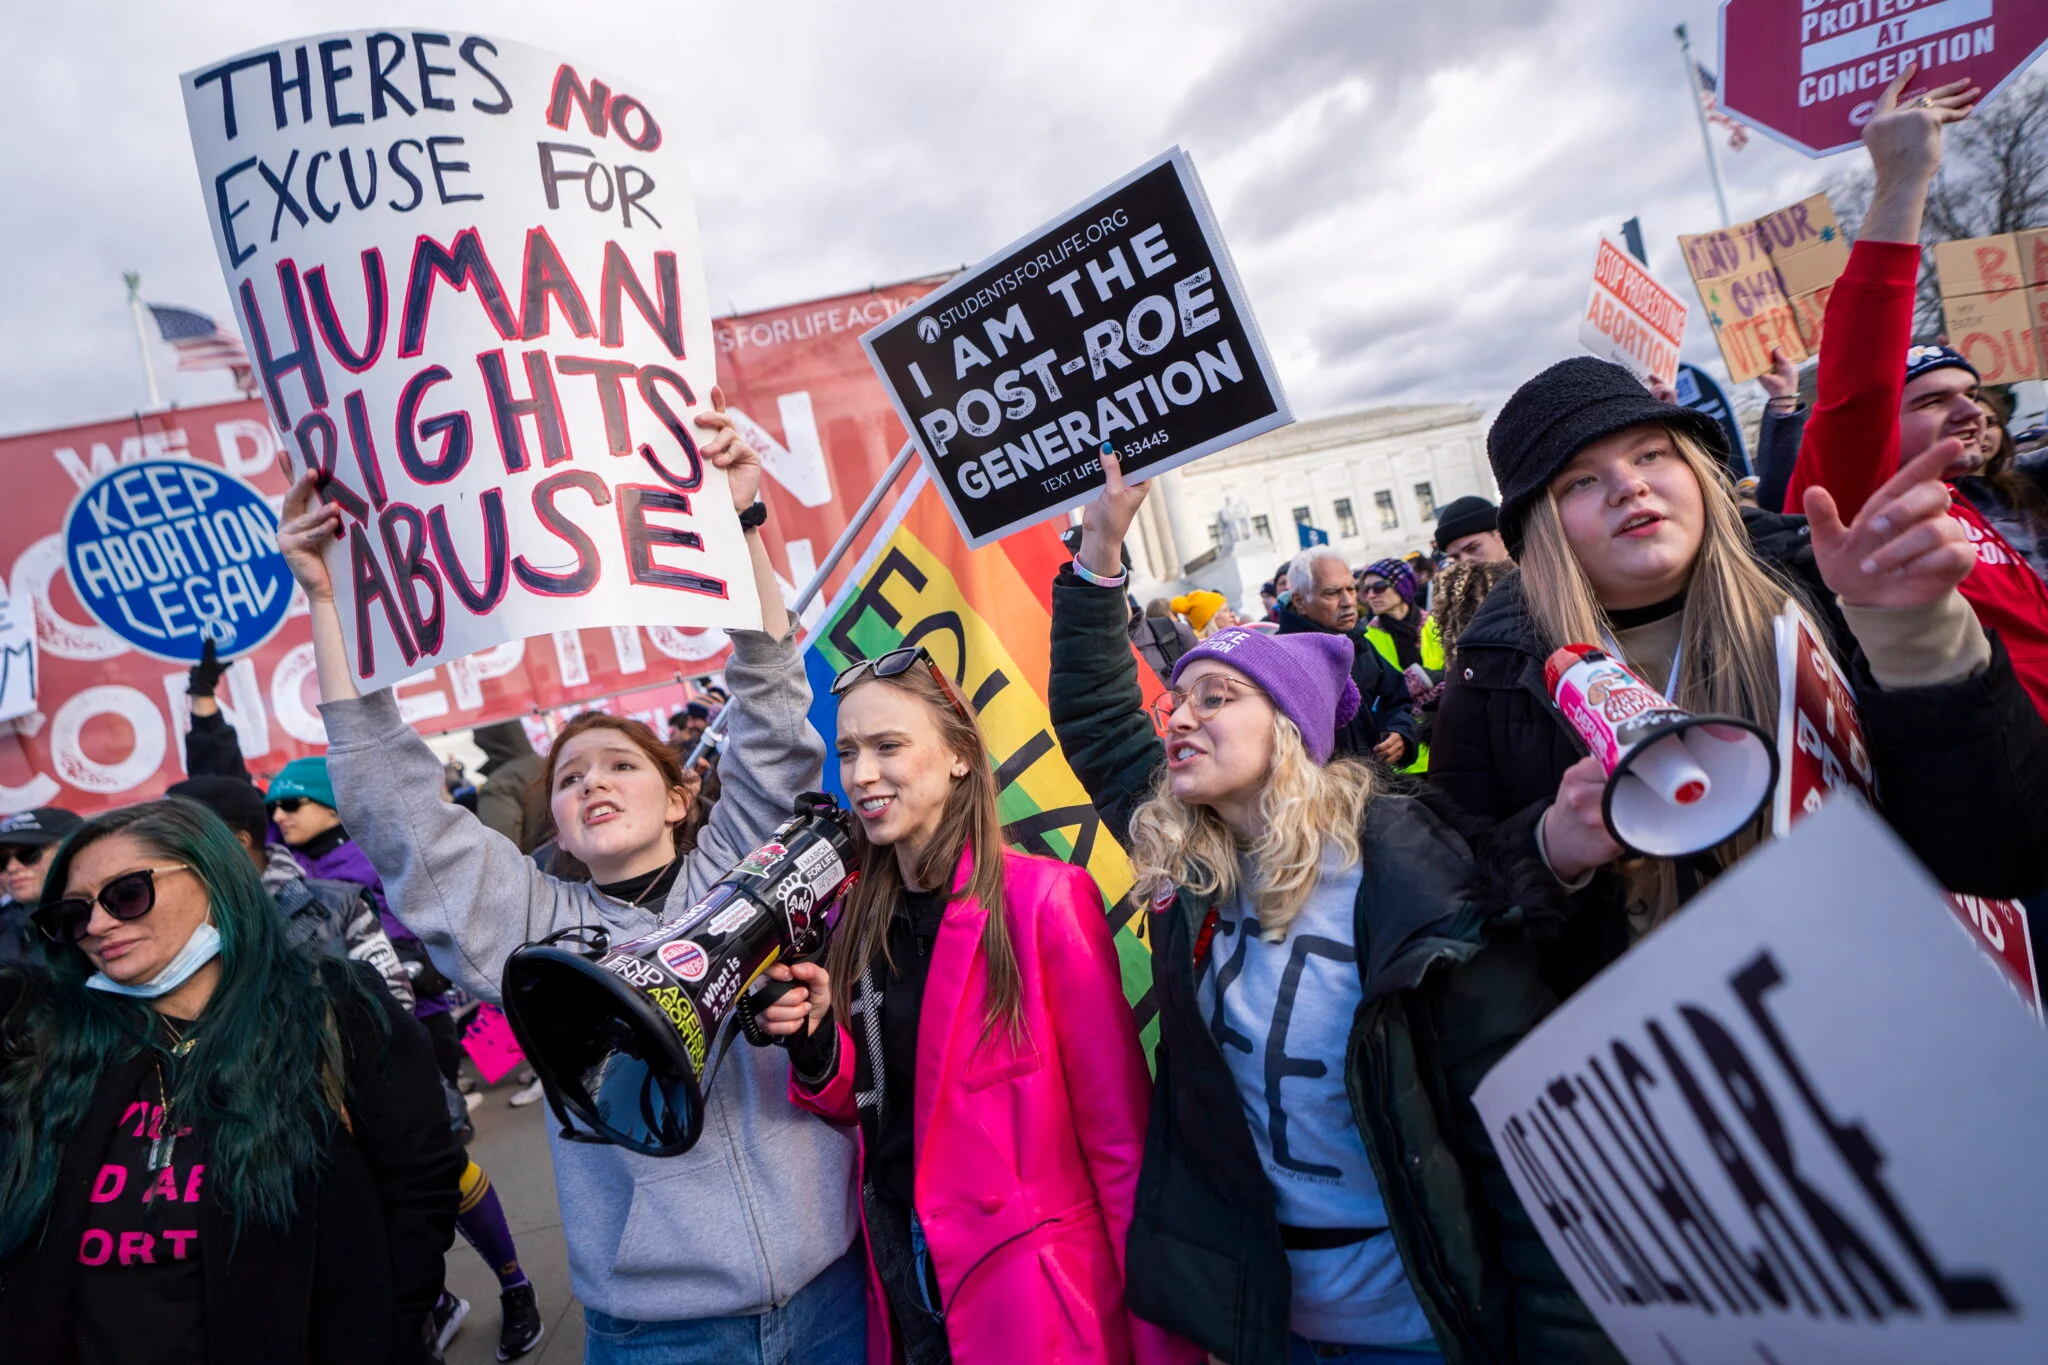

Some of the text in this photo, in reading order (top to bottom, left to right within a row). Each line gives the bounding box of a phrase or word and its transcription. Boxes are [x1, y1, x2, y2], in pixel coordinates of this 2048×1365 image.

[1798, 24, 1995, 108] CONCEPTION
[1876, 18, 1909, 49] AT
[195, 32, 513, 141] THERES
[546, 63, 662, 152] NO
[214, 137, 662, 270] EXCUSE FOR
[1740, 203, 1817, 262] YOUR
[907, 222, 1177, 399] I AM THE
[938, 208, 1129, 331] STUDENTSFORLIFE.ORG
[1597, 244, 1625, 291] STOP
[238, 226, 687, 432] HUMAN
[918, 267, 1221, 457] POST-ROE
[1586, 290, 1678, 384] ABORTION
[294, 349, 703, 540] RIGHTS
[956, 339, 1244, 499] GENERATION
[1041, 470, 1073, 494] TEXT
[1073, 458, 1103, 481] LIFE
[1124, 428, 1170, 460] 53445
[87, 465, 219, 536] KEEP
[75, 510, 280, 598] ABORTION
[350, 470, 729, 678] ABUSE
[117, 563, 279, 640] LEGAL
[802, 844, 829, 866] MARCH
[806, 863, 823, 880] FOR
[820, 852, 838, 870] LIFE
[636, 904, 708, 944] DEFUND
[788, 894, 810, 913] AM
[604, 960, 648, 987] END
[613, 954, 664, 985] END
[701, 956, 741, 1009] What is
[646, 987, 704, 1083] ABORTION
[1500, 945, 2022, 1322] HEALTHCARE
